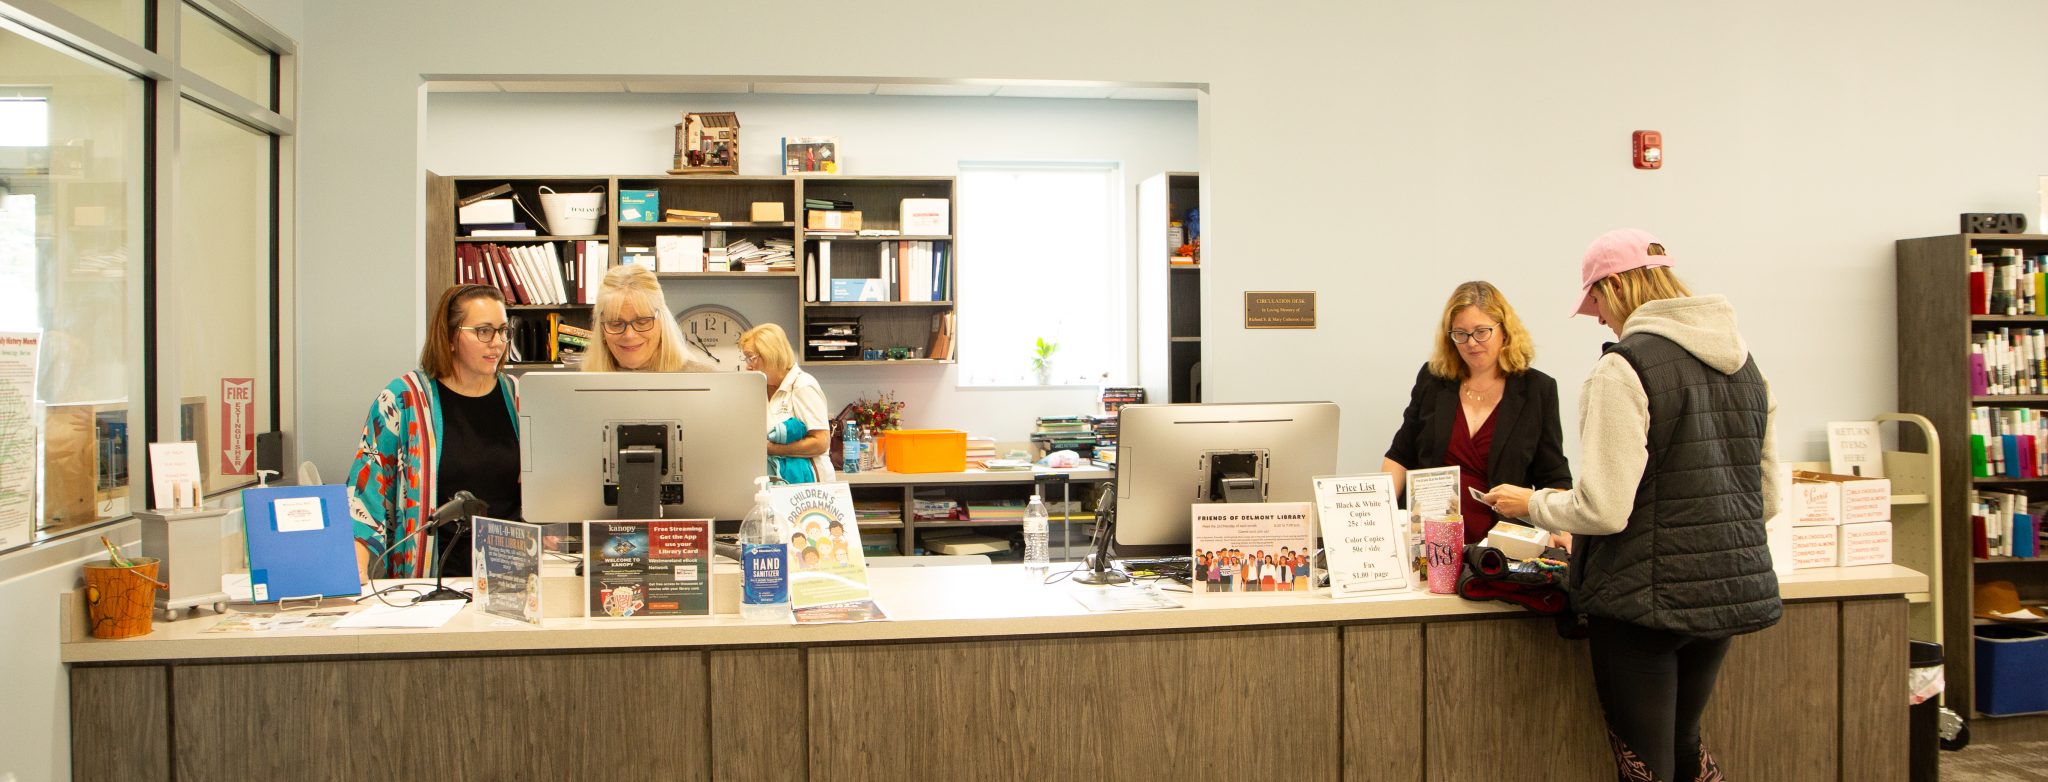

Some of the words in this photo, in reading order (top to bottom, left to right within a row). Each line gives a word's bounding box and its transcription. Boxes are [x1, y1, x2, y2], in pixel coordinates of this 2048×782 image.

[1967, 213, 2027, 234] READ
[705, 317, 717, 331] 12
[723, 321, 727, 334] 1
[226, 387, 249, 400] FIRE
[234, 402, 242, 466] EXTINGUISHER
[1835, 427, 1870, 436] RETURN
[1841, 441, 1868, 449] ITEMS
[1844, 454, 1867, 462] HERE
[1335, 483, 1357, 492] Price
[1359, 482, 1376, 491] List
[790, 489, 836, 506] CHILDRENS
[1336, 501, 1354, 509] Black
[788, 500, 845, 524] PROGRAMMING
[487, 523, 525, 539] HOWL-O-WEEN
[608, 524, 637, 533] kanopy
[486, 534, 494, 546] AT
[495, 535, 504, 548] THE
[505, 537, 526, 554] LIBRARY
[1363, 535, 1385, 543] Copies
[752, 557, 780, 571] HAND
[1363, 561, 1376, 569] Fax
[752, 570, 780, 578] SANITIZER
[1352, 571, 1369, 579] $1.00
[1374, 571, 1389, 579] page
